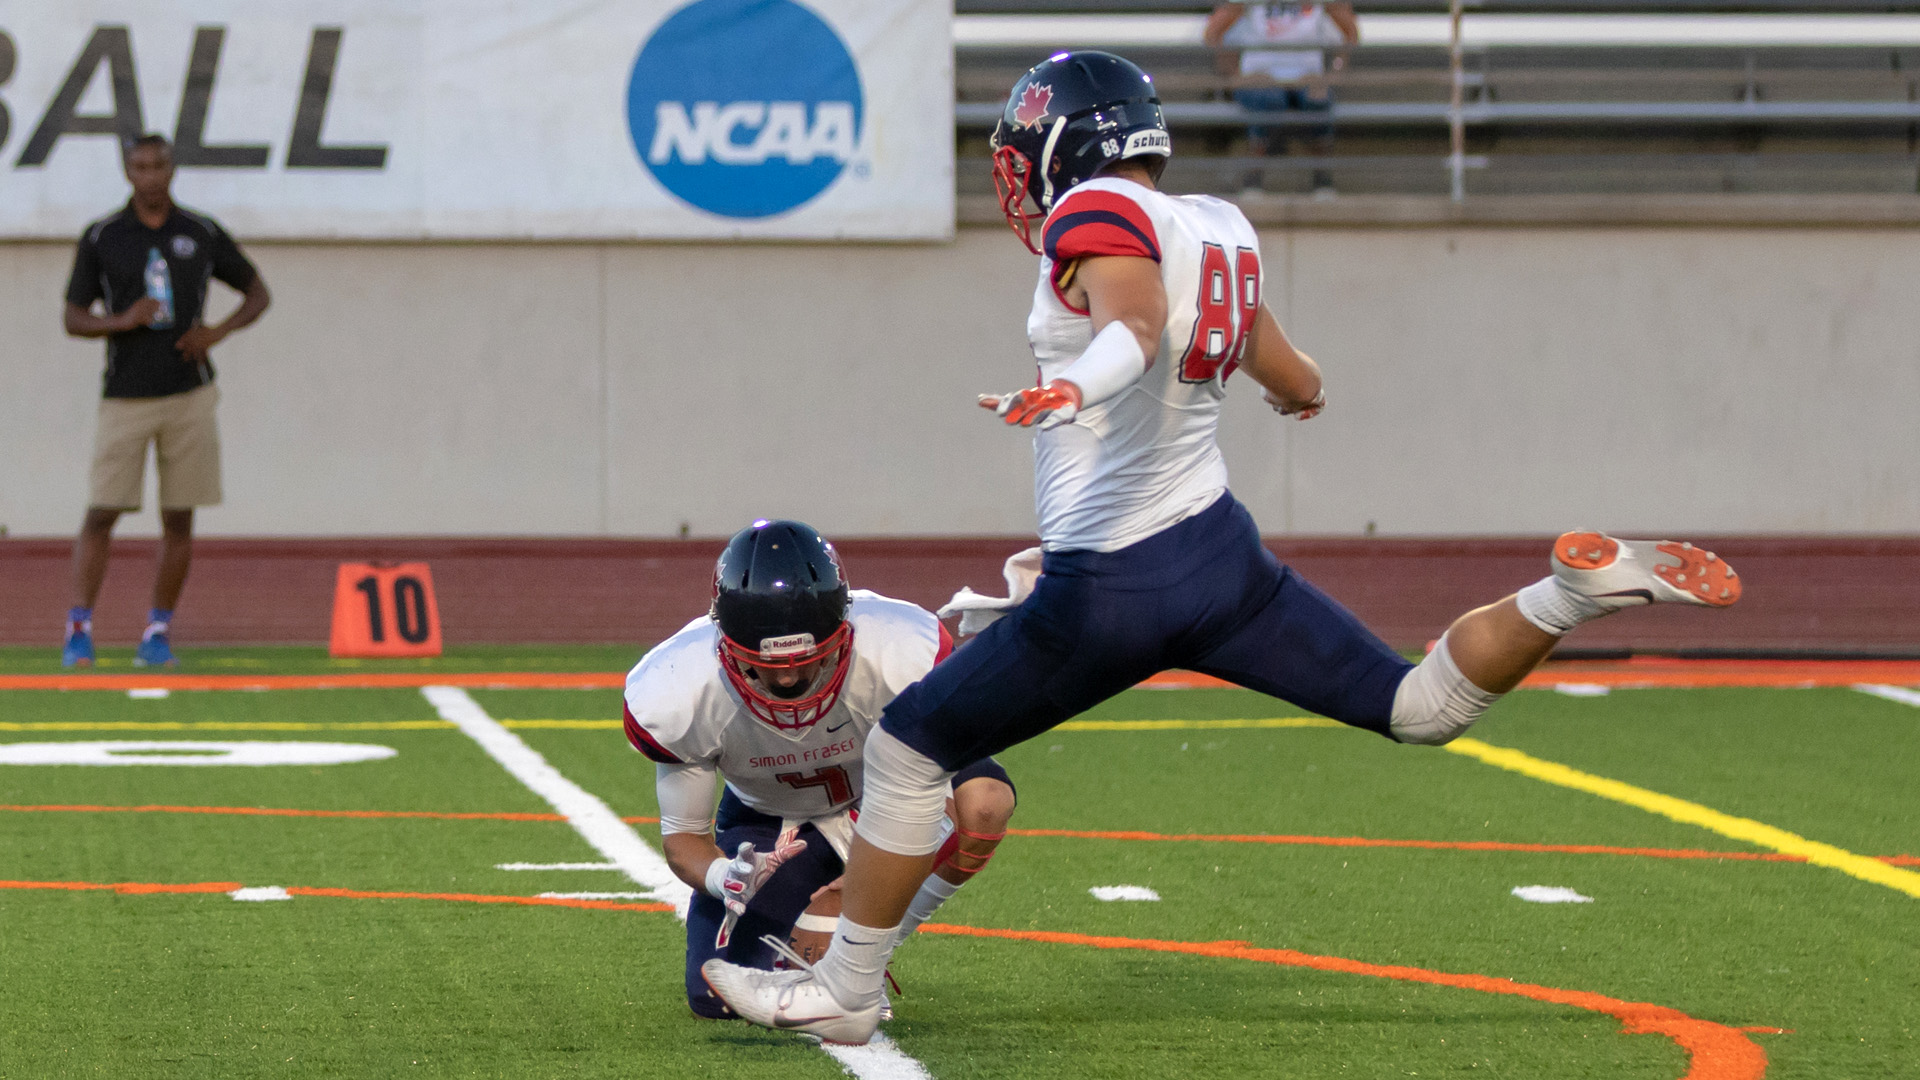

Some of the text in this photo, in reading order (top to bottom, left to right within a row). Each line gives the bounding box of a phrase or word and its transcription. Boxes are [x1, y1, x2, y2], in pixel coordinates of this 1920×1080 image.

[0, 24, 391, 170] ALL
[649, 100, 860, 165] NCAA
[1101, 138, 1120, 158] 88
[1178, 241, 1260, 388] 88
[355, 576, 429, 644] 10
[773, 637, 803, 649] Riddell
[775, 764, 855, 807] 4
